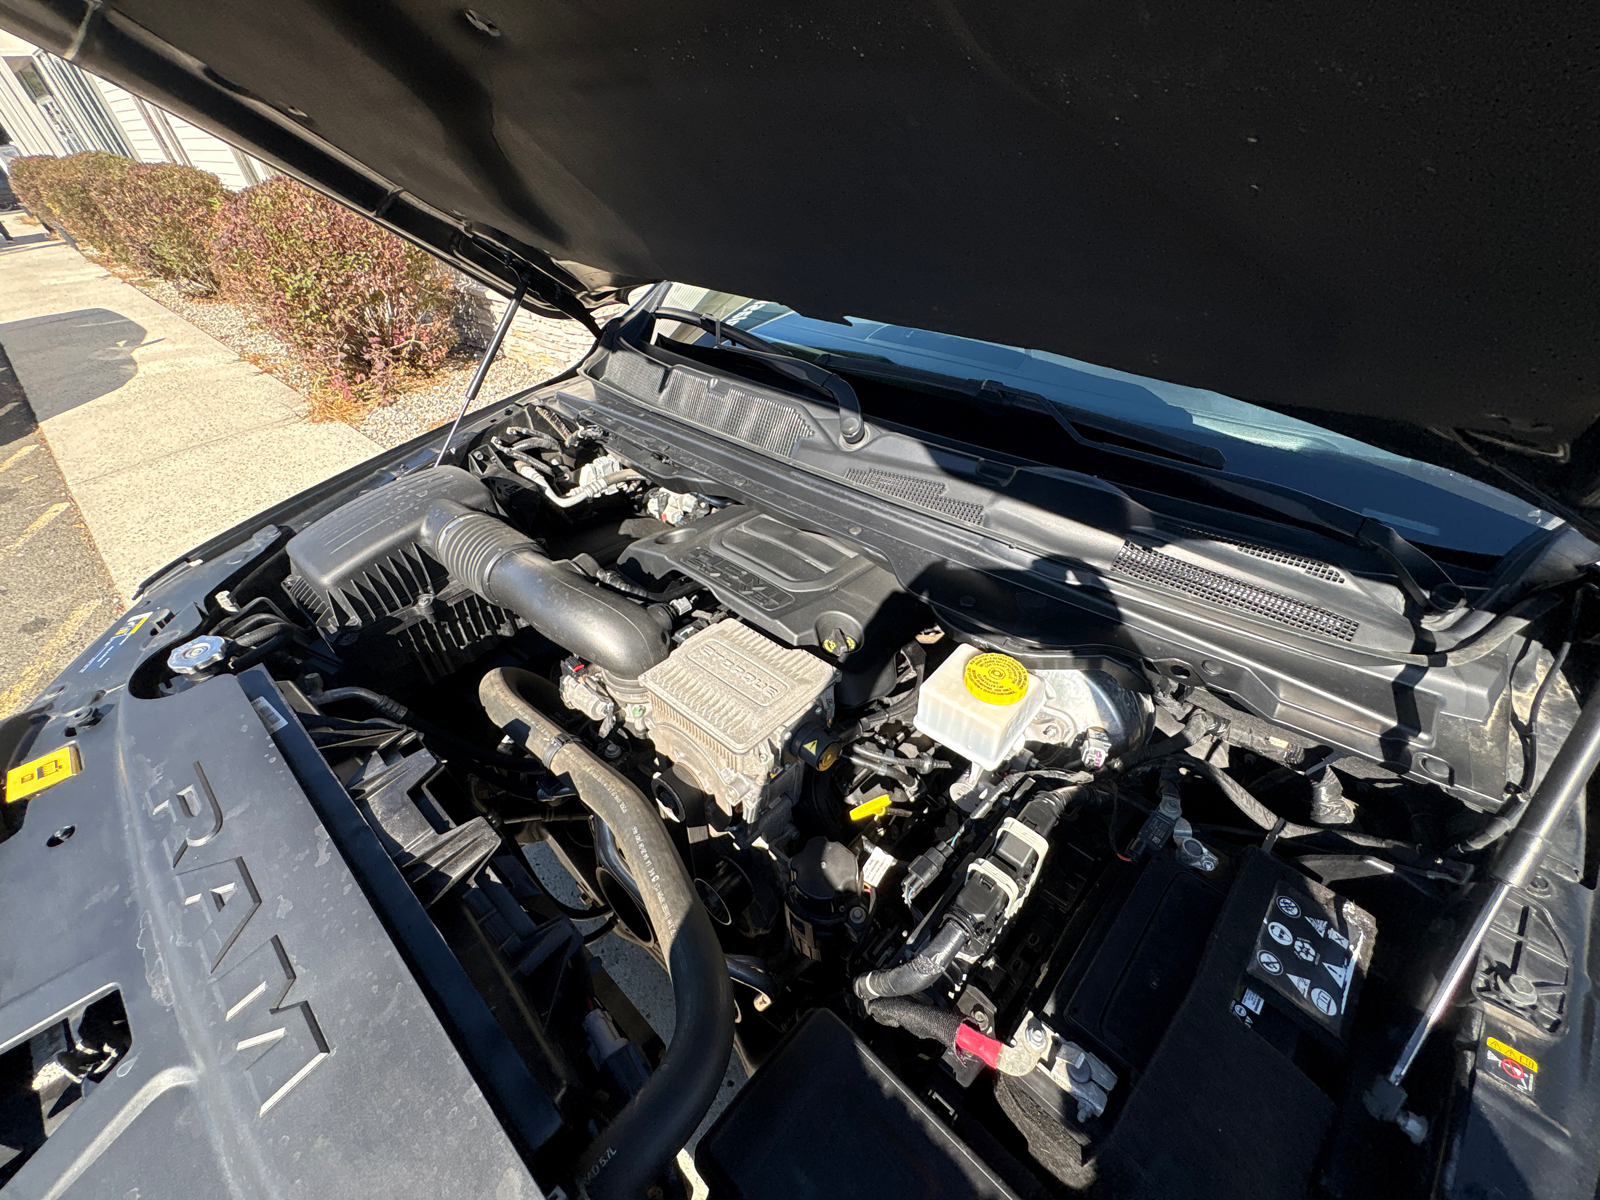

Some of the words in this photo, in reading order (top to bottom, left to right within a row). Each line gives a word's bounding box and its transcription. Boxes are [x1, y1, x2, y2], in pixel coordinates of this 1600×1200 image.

[689, 548, 790, 605] HEMI
[152, 761, 331, 1118] RAM
[599, 1147, 617, 1167] 5.7L
